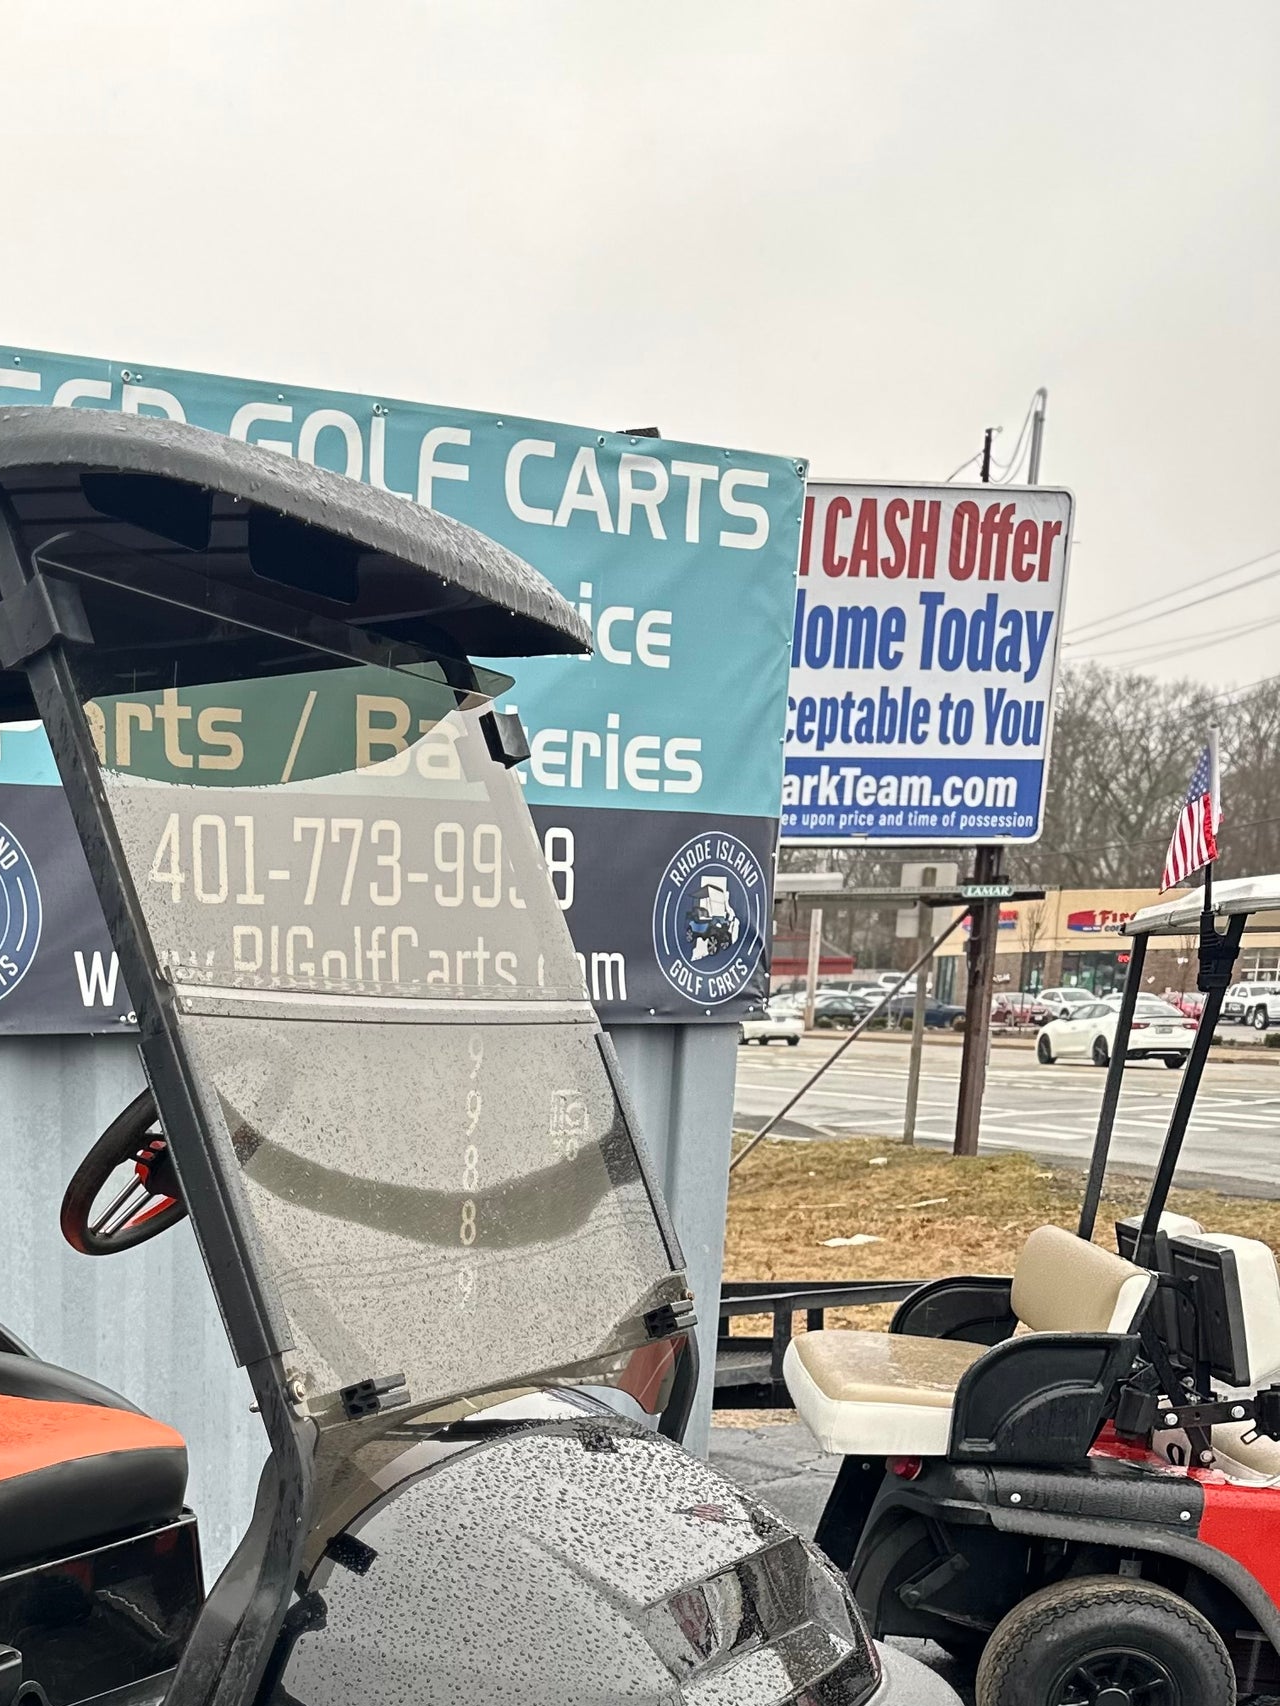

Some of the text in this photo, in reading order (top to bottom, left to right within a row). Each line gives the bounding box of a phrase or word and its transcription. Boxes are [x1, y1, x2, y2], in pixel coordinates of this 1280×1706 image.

[229, 402, 471, 510] GOLF
[504, 438, 770, 551] CARTS
[822, 496, 941, 580] CASH
[948, 500, 1063, 582] Offer
[919, 591, 1055, 684] Today
[355, 694, 704, 795] Baeries
[938, 692, 975, 746] to
[983, 687, 1046, 747] You
[801, 813, 836, 830] upon
[838, 810, 875, 830] price
[878, 810, 904, 827] and
[907, 810, 938, 827] time
[941, 810, 957, 827] of
[959, 811, 1034, 831] possession
[148, 812, 575, 911] 401-773-998
[669, 839, 759, 888] RHODE ISLAND
[967, 886, 1011, 897] LAMAR
[669, 958, 749, 998] GOLF CARTS
